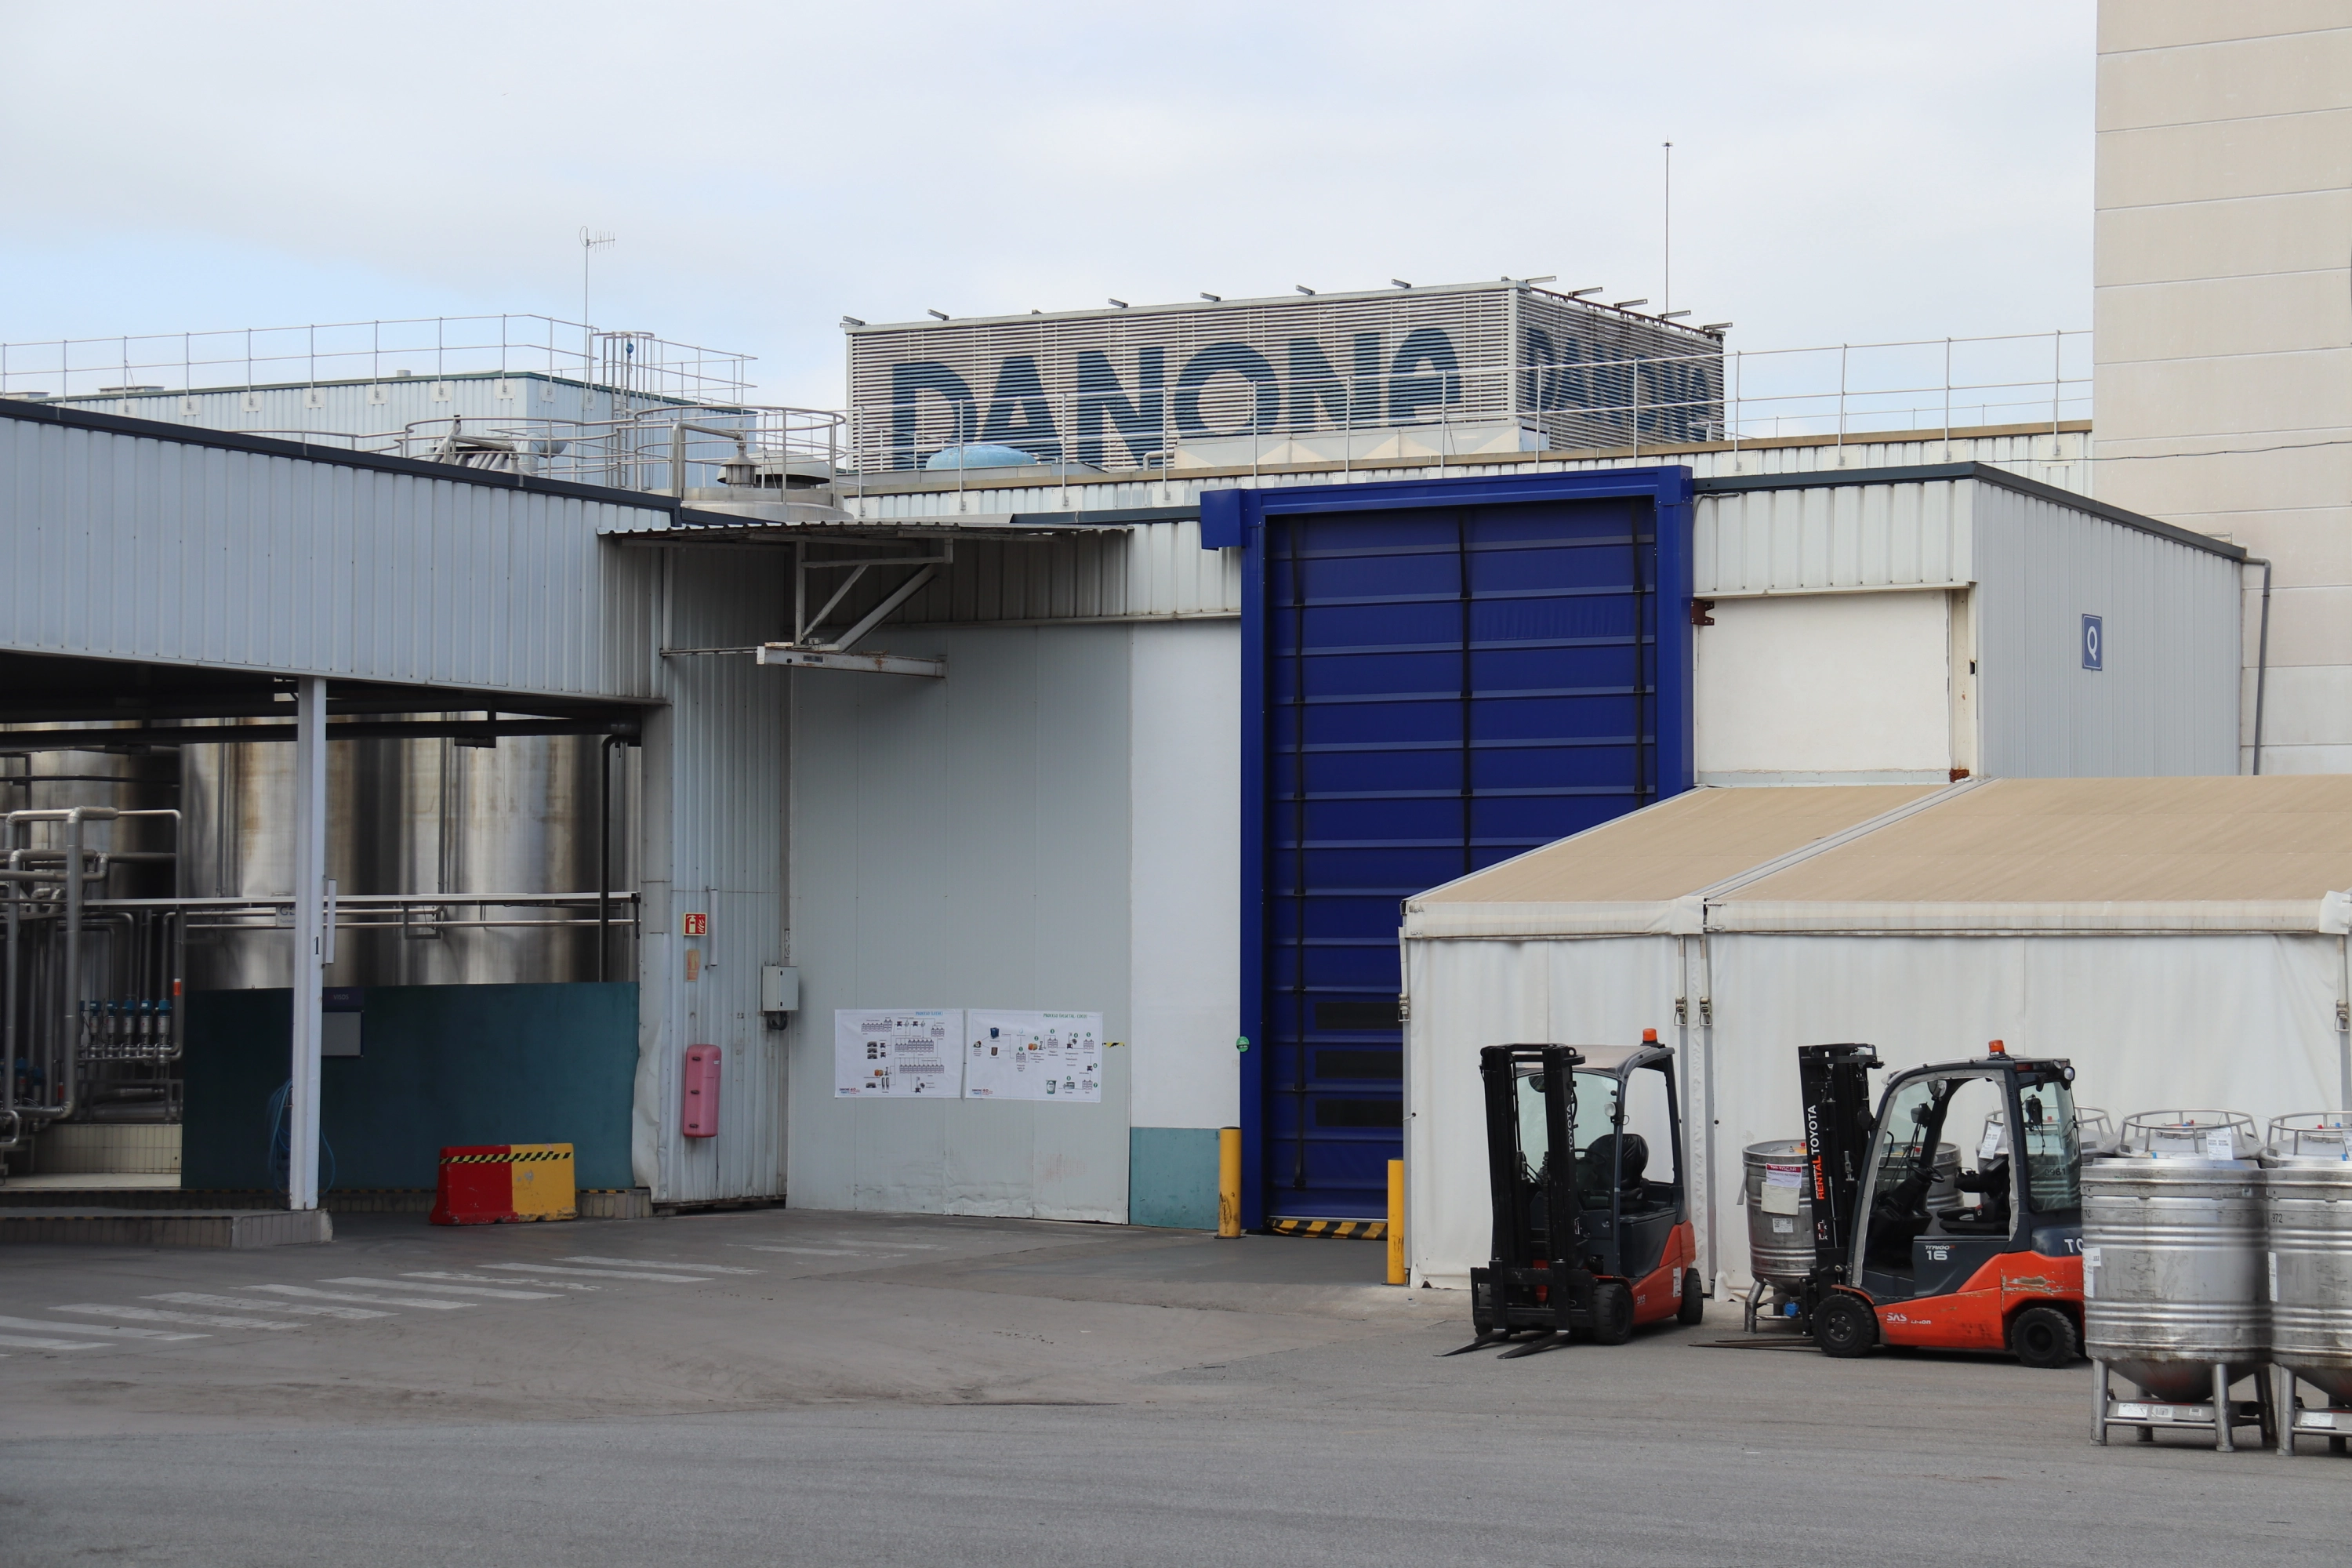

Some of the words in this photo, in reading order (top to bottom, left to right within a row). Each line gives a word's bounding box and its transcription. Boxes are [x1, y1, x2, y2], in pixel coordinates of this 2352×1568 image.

[2087, 626, 2098, 661] Q
[280, 906, 296, 916] GE
[314, 936, 319, 955] 1
[1807, 1105, 1820, 1155] TOYOTA
[1812, 1155, 1825, 1200] RENTAL
[2270, 1213, 2283, 1223] 972
[1926, 1250, 1947, 1261] 16
[1637, 1294, 1646, 1305] SAS
[1886, 1312, 1907, 1322] SAS
